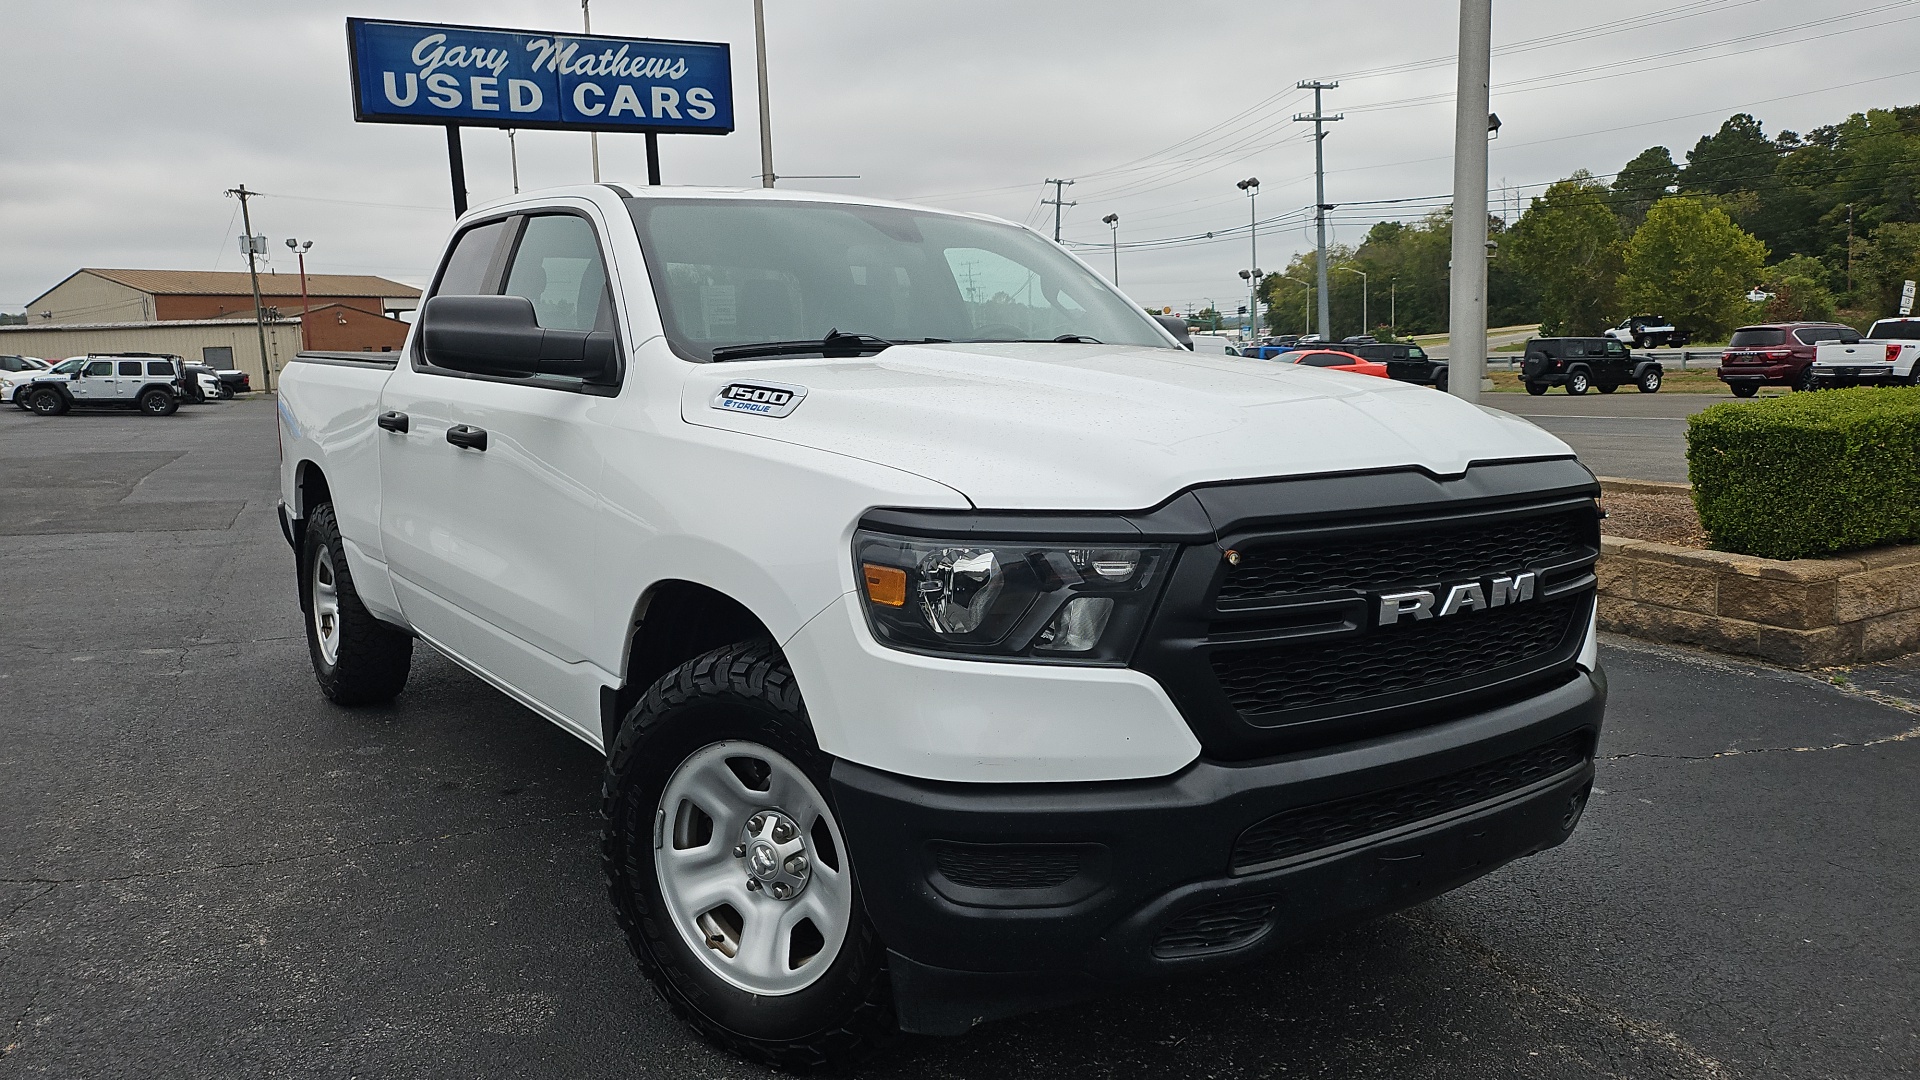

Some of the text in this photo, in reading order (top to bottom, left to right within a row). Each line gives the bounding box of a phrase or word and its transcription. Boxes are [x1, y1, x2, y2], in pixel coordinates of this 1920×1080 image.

[411, 33, 689, 80] Gary Mathews
[384, 71, 717, 121] USED CARS
[727, 386, 791, 405] 1500
[1379, 572, 1536, 626] RAM
